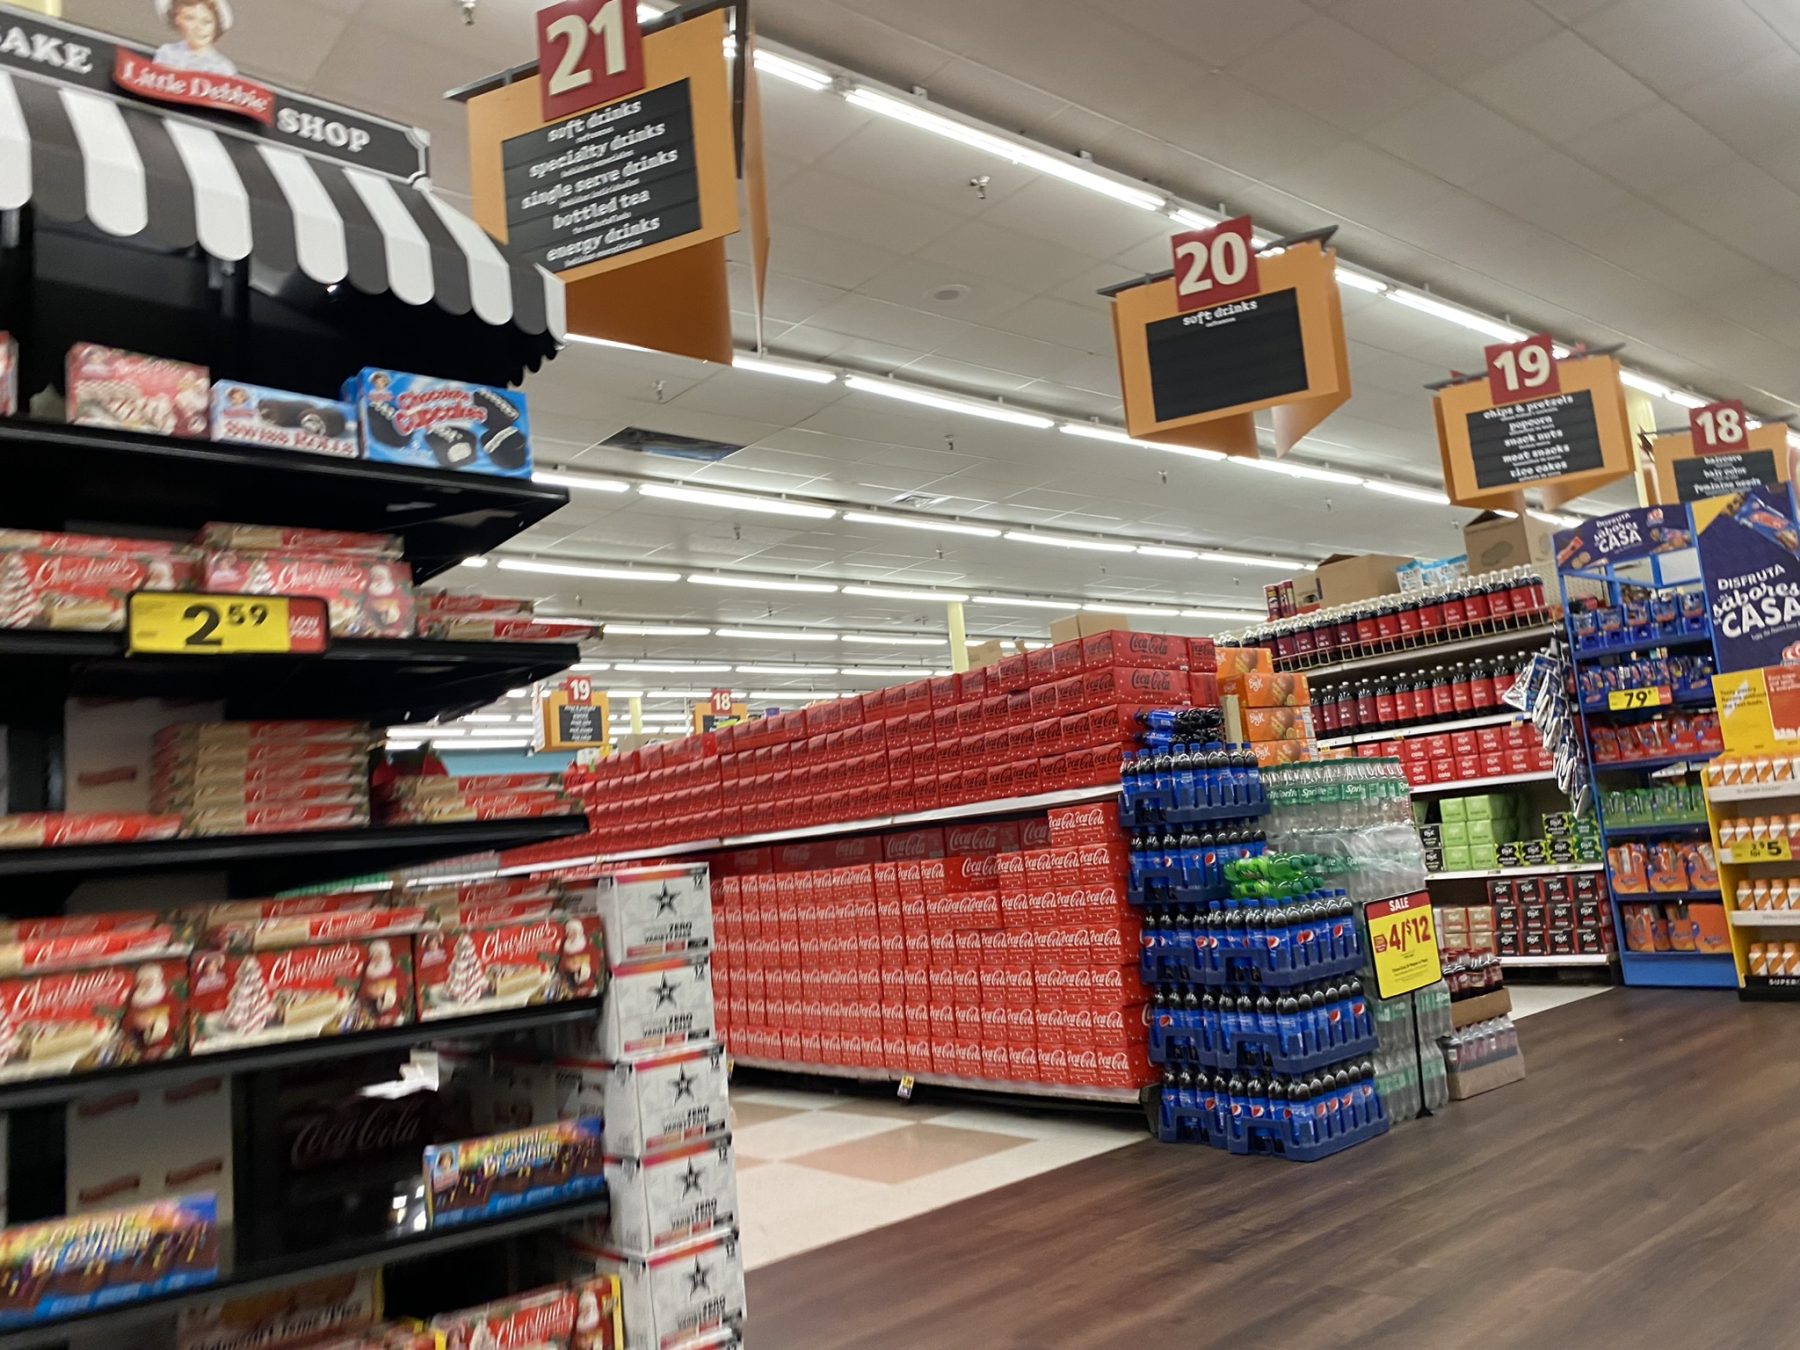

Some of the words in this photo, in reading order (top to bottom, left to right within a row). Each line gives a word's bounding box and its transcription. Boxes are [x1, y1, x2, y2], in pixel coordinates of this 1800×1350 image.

[0, 26, 94, 74] AKE
[546, 0, 627, 96] 21
[122, 61, 186, 95] Little
[189, 77, 268, 112] Debbie
[277, 107, 371, 152] SHOP
[547, 118, 585, 142] soft
[586, 101, 642, 128] drinks
[610, 123, 665, 150] drinks
[521, 183, 573, 209] single
[574, 169, 620, 192] serve
[622, 149, 678, 177] drinks
[553, 197, 618, 229] bottled
[619, 190, 650, 208] tea
[546, 235, 604, 262] energy
[605, 217, 660, 244] drinks
[1175, 232, 1248, 296] 20
[1183, 312, 1213, 327] soft
[1213, 301, 1258, 319] drinks
[1493, 345, 1551, 392] 19
[1508, 416, 1553, 432] popcorn
[1695, 408, 1743, 445] 18
[1502, 450, 1531, 463] meat
[1531, 444, 1570, 459] snacks
[1504, 435, 1536, 447] snack
[1599, 529, 1642, 553] CASA
[1717, 563, 1786, 591] DISFRUTA
[1722, 596, 1800, 638] CASA
[569, 679, 591, 701] 19
[713, 692, 731, 711] 18
[1345, 784, 1365, 795] Spri
[1388, 897, 1409, 912] SALE
[669, 922, 692, 932] ZERO
[482, 925, 558, 962] Christmas
[269, 945, 360, 987] Christmas
[669, 1013, 693, 1025] ZERO
[687, 1105, 710, 1119] ZERO
[695, 1199, 718, 1213] ZERO
